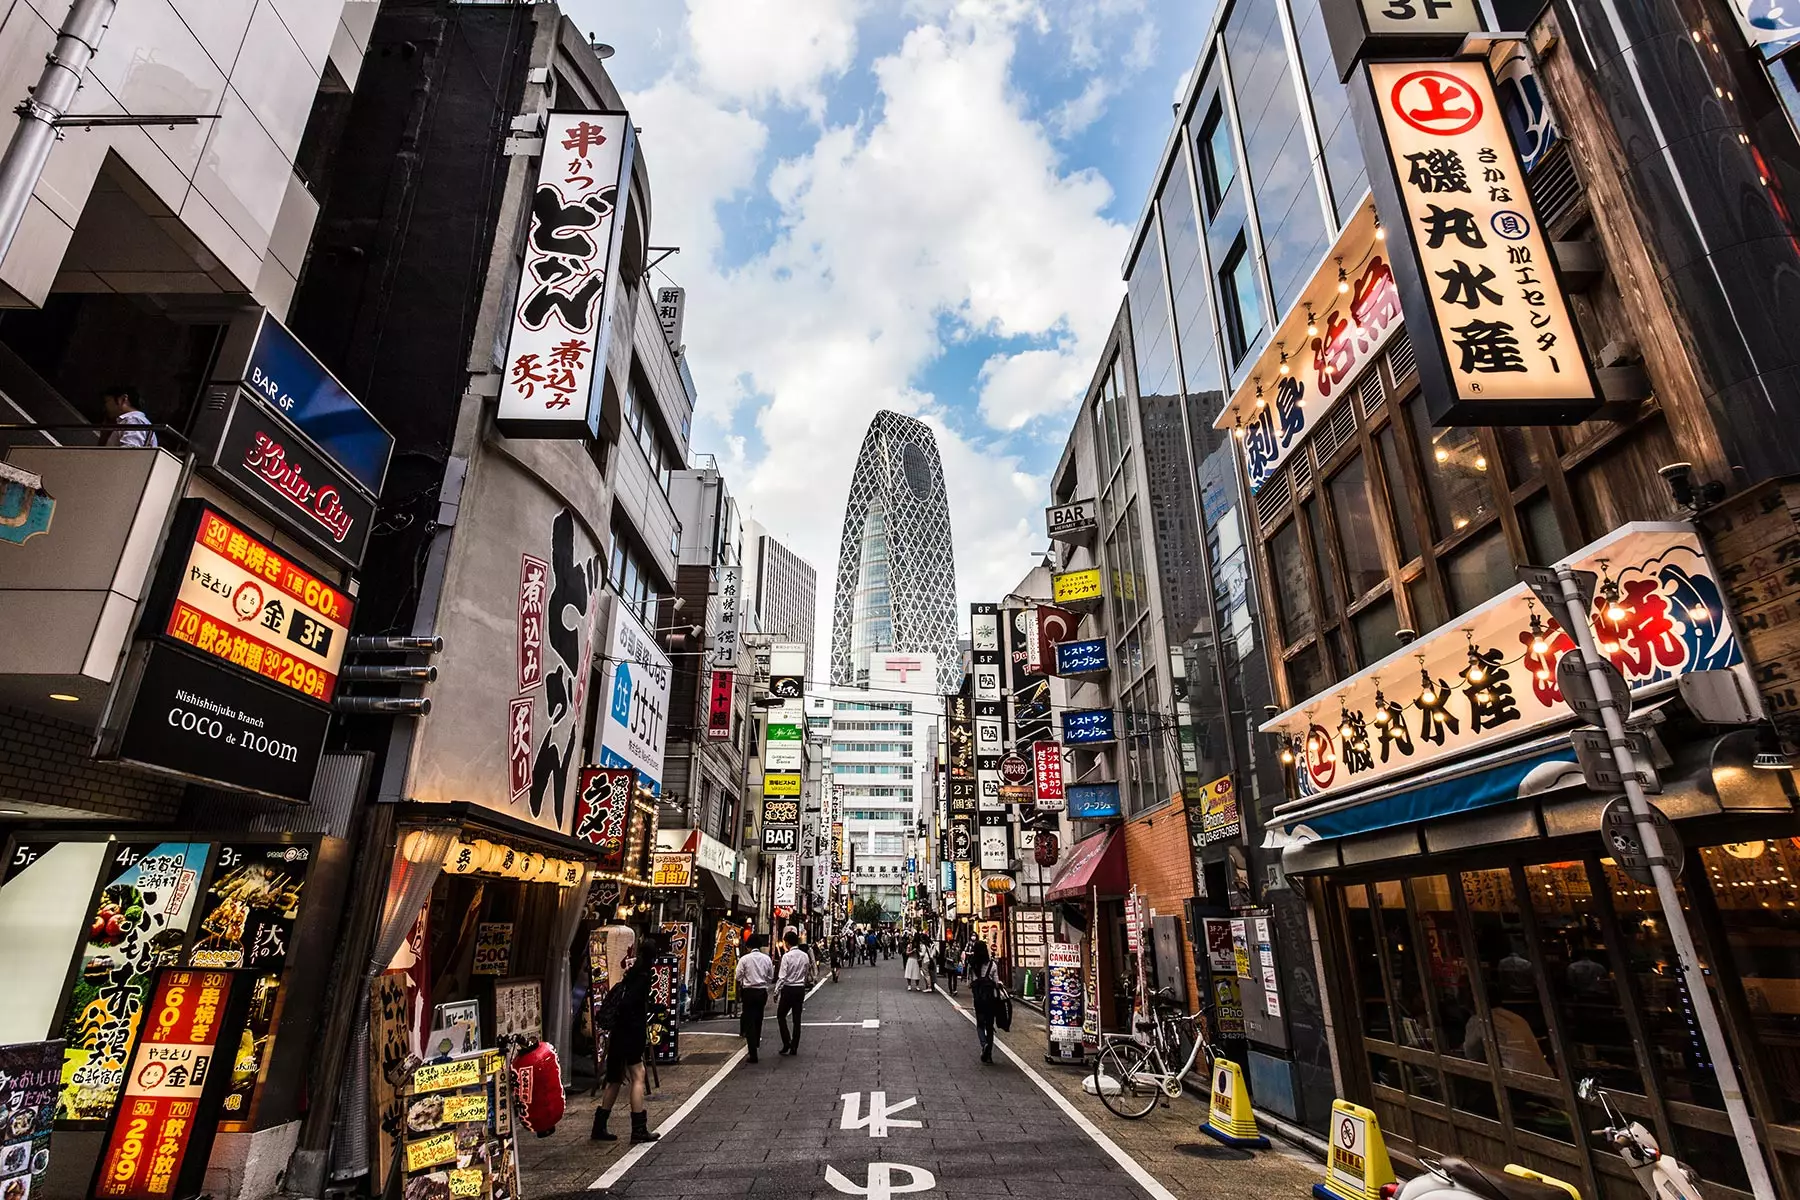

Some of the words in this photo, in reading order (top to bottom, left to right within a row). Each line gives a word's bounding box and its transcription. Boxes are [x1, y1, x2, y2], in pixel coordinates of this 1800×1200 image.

[1409, 77, 1472, 122] 上
[561, 121, 607, 191] 串かつ
[1477, 147, 1514, 203] さかな
[1501, 216, 1522, 235] 貝
[1403, 148, 1528, 375] 磯丸水産
[1506, 245, 1561, 374] 加工センター
[510, 354, 546, 400] 炙り
[543, 339, 591, 411] 煮込み
[1246, 376, 1305, 482] 刺身
[1310, 255, 1402, 397] 活魚
[252, 367, 278, 400] BAR
[279, 390, 295, 411] 6F
[243, 431, 354, 543] Kirin-City
[1054, 507, 1084, 524] BAR
[207, 520, 227, 540] 30
[226, 532, 281, 582] 串焼き
[286, 573, 303, 593] 1串
[304, 579, 334, 615] 60
[722, 570, 737, 624] 本格焼酎
[1058, 583, 1097, 597] チャンカヤ
[190, 566, 232, 598] やきとり
[261, 599, 285, 634] 金
[300, 620, 326, 649] 3F
[180, 610, 199, 634] 70
[522, 566, 544, 684] 煮込み
[197, 621, 264, 672] 飲み放題
[619, 621, 668, 692] お部屋探しなら
[1064, 645, 1101, 656] レストラン
[980, 655, 993, 663] 5F
[176, 690, 236, 719] Nishishinjuku
[238, 711, 264, 728] Branch
[1069, 715, 1107, 725] レストラン
[1337, 647, 1522, 776] 磯丸水産
[226, 733, 236, 744] de
[240, 728, 299, 763] noom
[511, 703, 533, 789] 炙り
[984, 760, 997, 768] 3F
[1004, 764, 1025, 775] 消火栓
[1037, 750, 1048, 792] だるまや
[1047, 746, 1056, 795] ジンギスカン
[1052, 746, 1062, 795] 炭火焼生ラム
[953, 785, 974, 794] 2F
[1075, 790, 1112, 798] レストラン
[577, 773, 614, 846] ラーメ
[609, 775, 629, 837] 横浜家系
[952, 799, 975, 809] 個室
[986, 816, 1000, 824] 2F
[766, 830, 794, 844] BAR
[13, 847, 37, 866] 5F
[116, 847, 139, 866] 4F
[139, 854, 184, 875] 佐賀県
[219, 847, 242, 866] 3F
[137, 873, 178, 890] 三瀬村
[654, 870, 690, 885] 自由!!
[777, 864, 786, 899] チャーハン
[856, 865, 902, 874] 新宿郵便
[477, 947, 509, 963] 500
[173, 973, 189, 984] 1串
[204, 974, 219, 986] 30
[159, 987, 186, 1027] 60
[190, 987, 220, 1043] 串焼き
[1219, 1007, 1244, 1018] iPho
[149, 1048, 192, 1061] やきとり
[72, 1066, 123, 1086] 西新宿店
[165, 1064, 189, 1088] 金
[193, 1058, 206, 1082] 3F
[172, 1103, 187, 1115] 70
[114, 1118, 148, 1181] 299
[148, 1118, 186, 1194] 飲み放題
